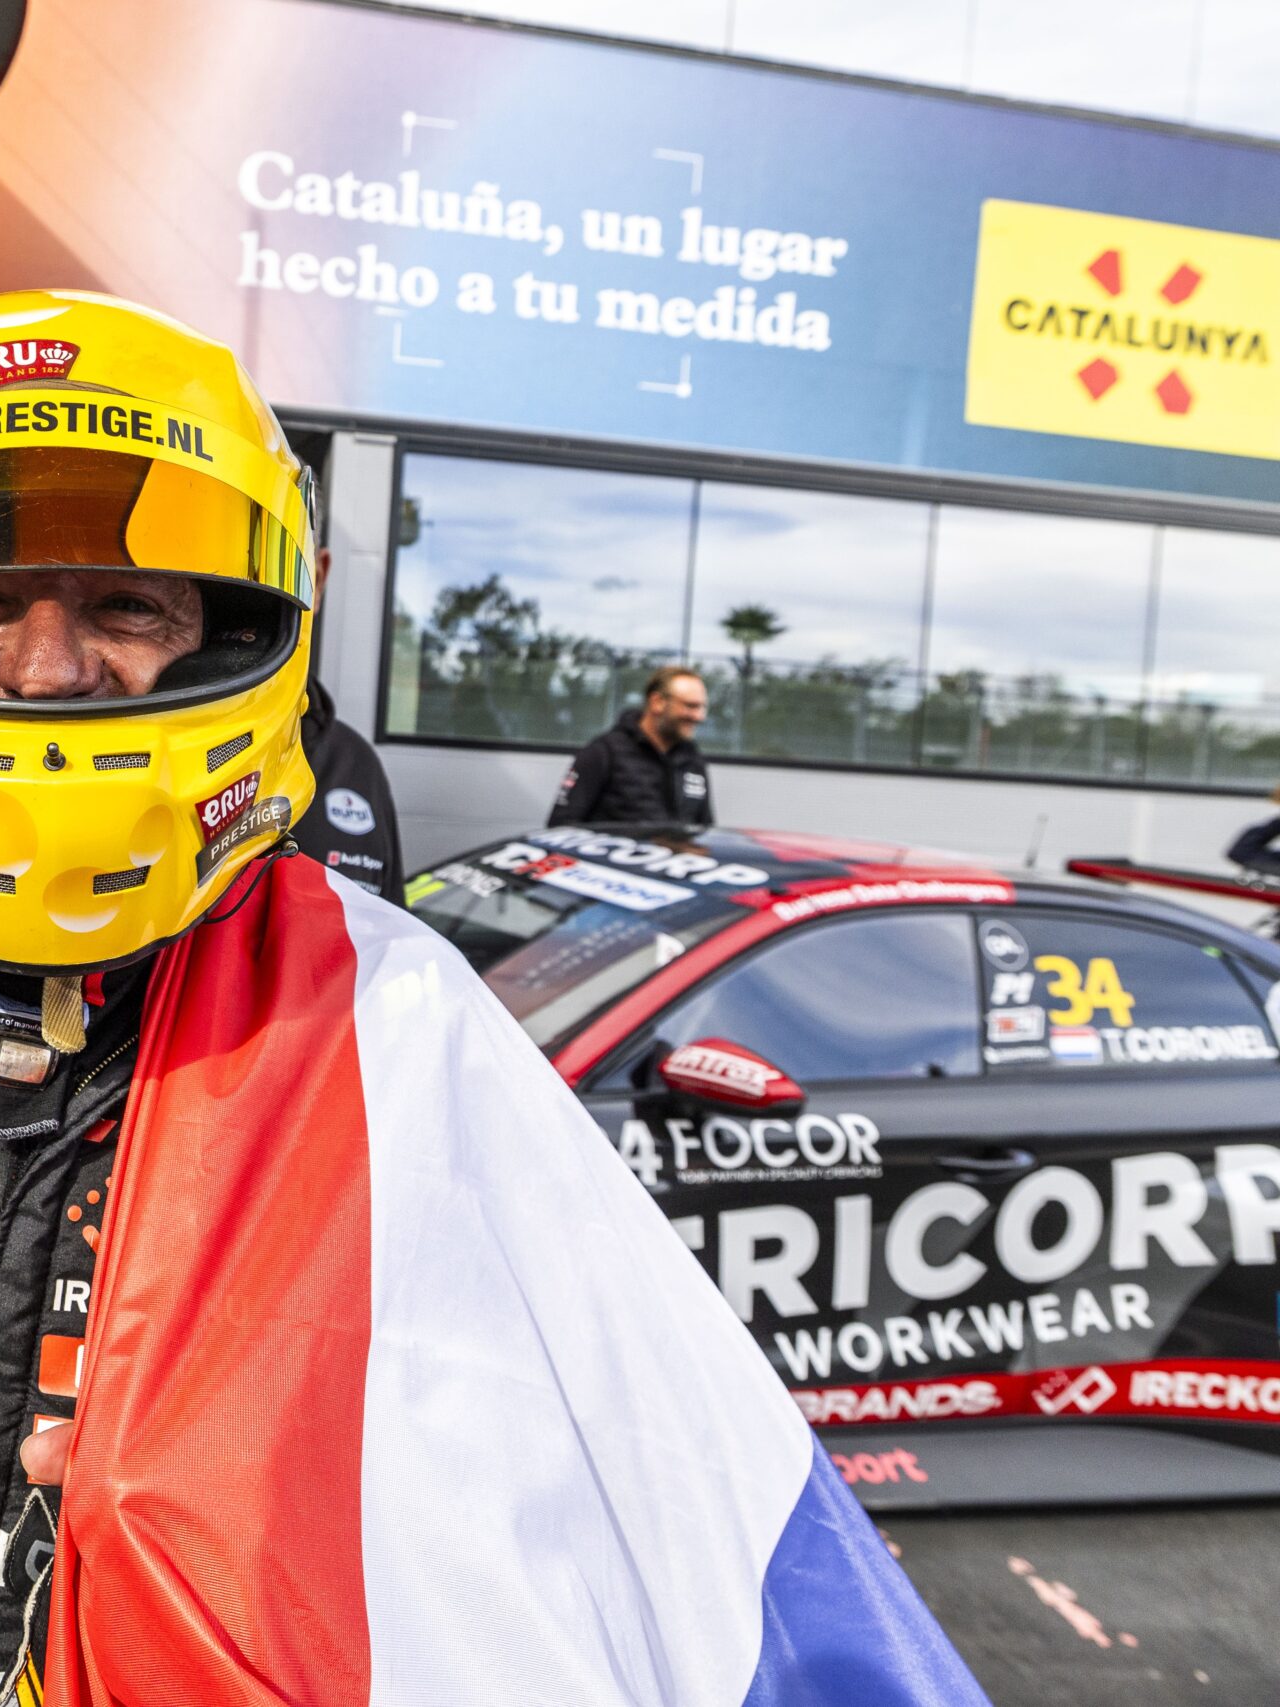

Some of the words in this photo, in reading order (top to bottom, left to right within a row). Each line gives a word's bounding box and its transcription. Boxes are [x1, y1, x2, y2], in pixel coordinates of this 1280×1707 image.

[237, 150, 565, 256] Cataluña,
[581, 206, 664, 257] un
[678, 207, 849, 281] lugar
[236, 232, 440, 306] hecho
[456, 271, 496, 315] a
[513, 271, 580, 323] tu
[595, 286, 832, 351] medida
[1004, 299, 1269, 364] CATALUNYA
[41, 366, 65, 374] 1824
[211, 804, 280, 860] PRESTIGE
[5, 1018, 14, 1026] of
[1033, 954, 1136, 1027] 34
[665, 1112, 884, 1171] FOCOR
[773, 1283, 1154, 1382] WORKWEAR
